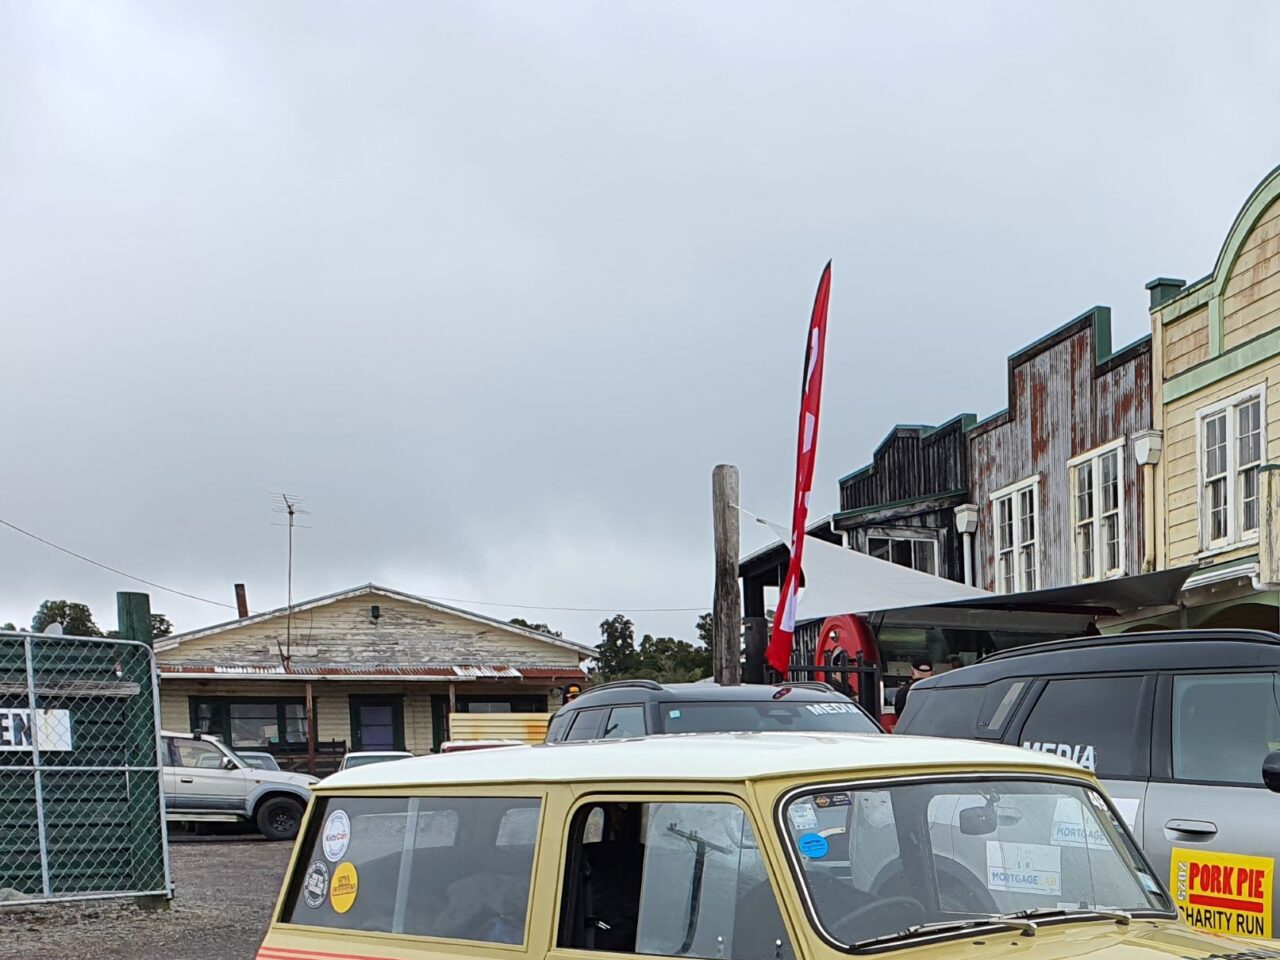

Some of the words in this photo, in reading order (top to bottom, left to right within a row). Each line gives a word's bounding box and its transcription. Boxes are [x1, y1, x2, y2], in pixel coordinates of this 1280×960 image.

[806, 703, 859, 716] MEDIA
[1177, 861, 1187, 901] 2025
[1188, 862, 1235, 896] PORK
[1236, 867, 1265, 900] PIE
[1178, 905, 1233, 931] HARITY
[1236, 913, 1264, 936] RUN
